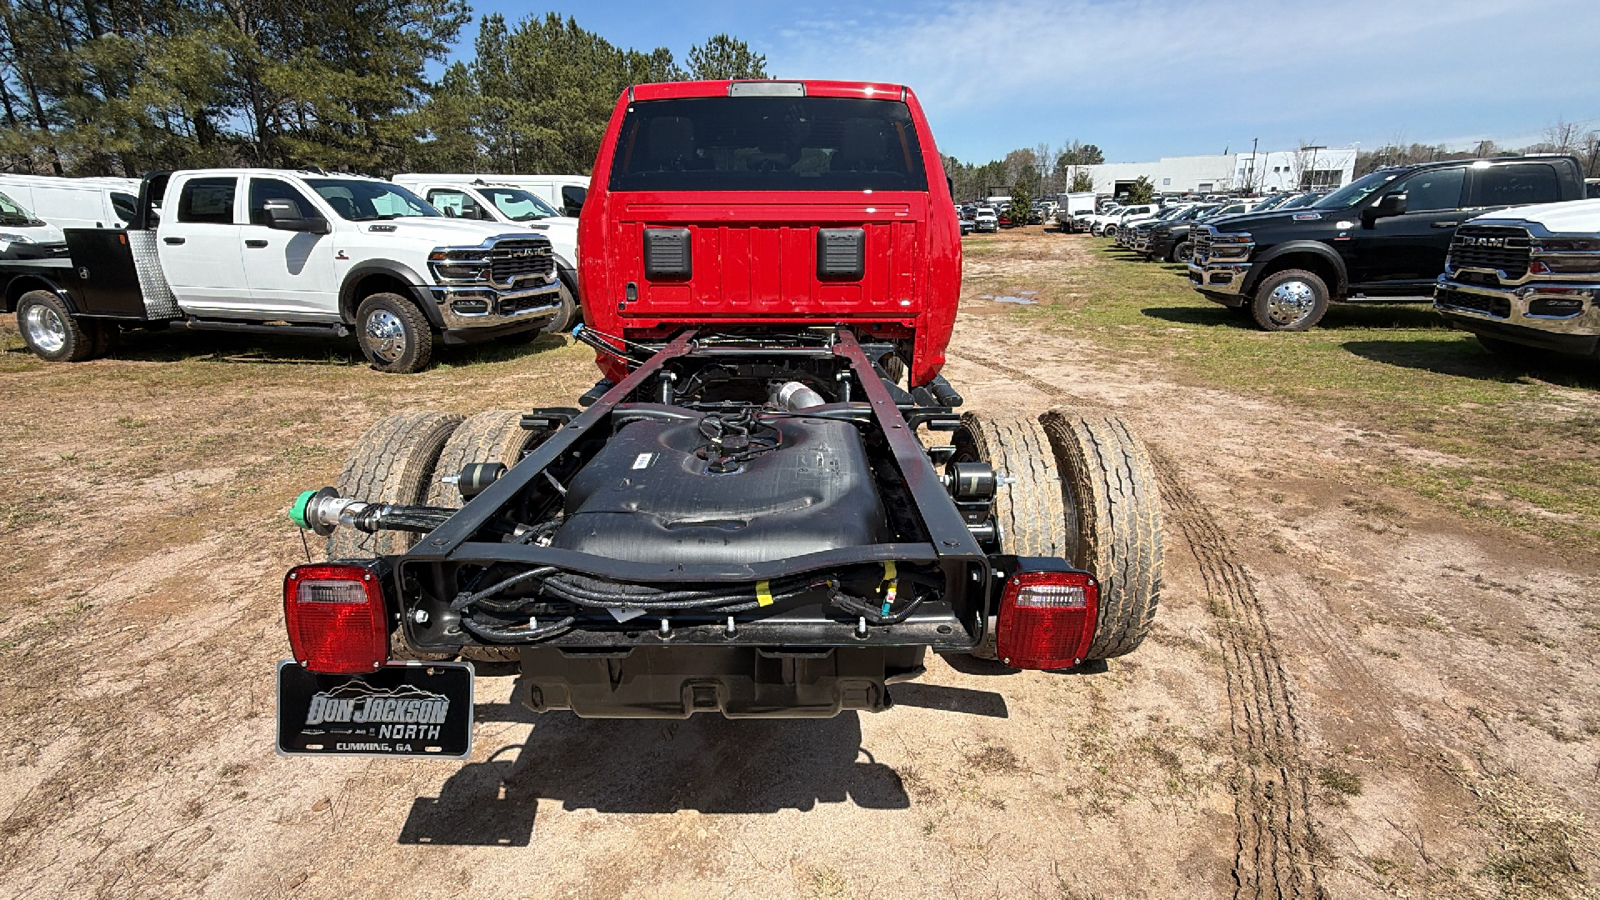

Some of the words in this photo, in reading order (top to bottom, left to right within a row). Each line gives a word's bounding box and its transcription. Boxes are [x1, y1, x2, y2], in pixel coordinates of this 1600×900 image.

[1464, 237, 1504, 247] RAM
[305, 695, 355, 725] DON
[352, 696, 450, 724] JACKSON
[379, 724, 439, 740] NORTH
[336, 742, 393, 752] CUMMING,
[396, 743, 412, 752] GA
